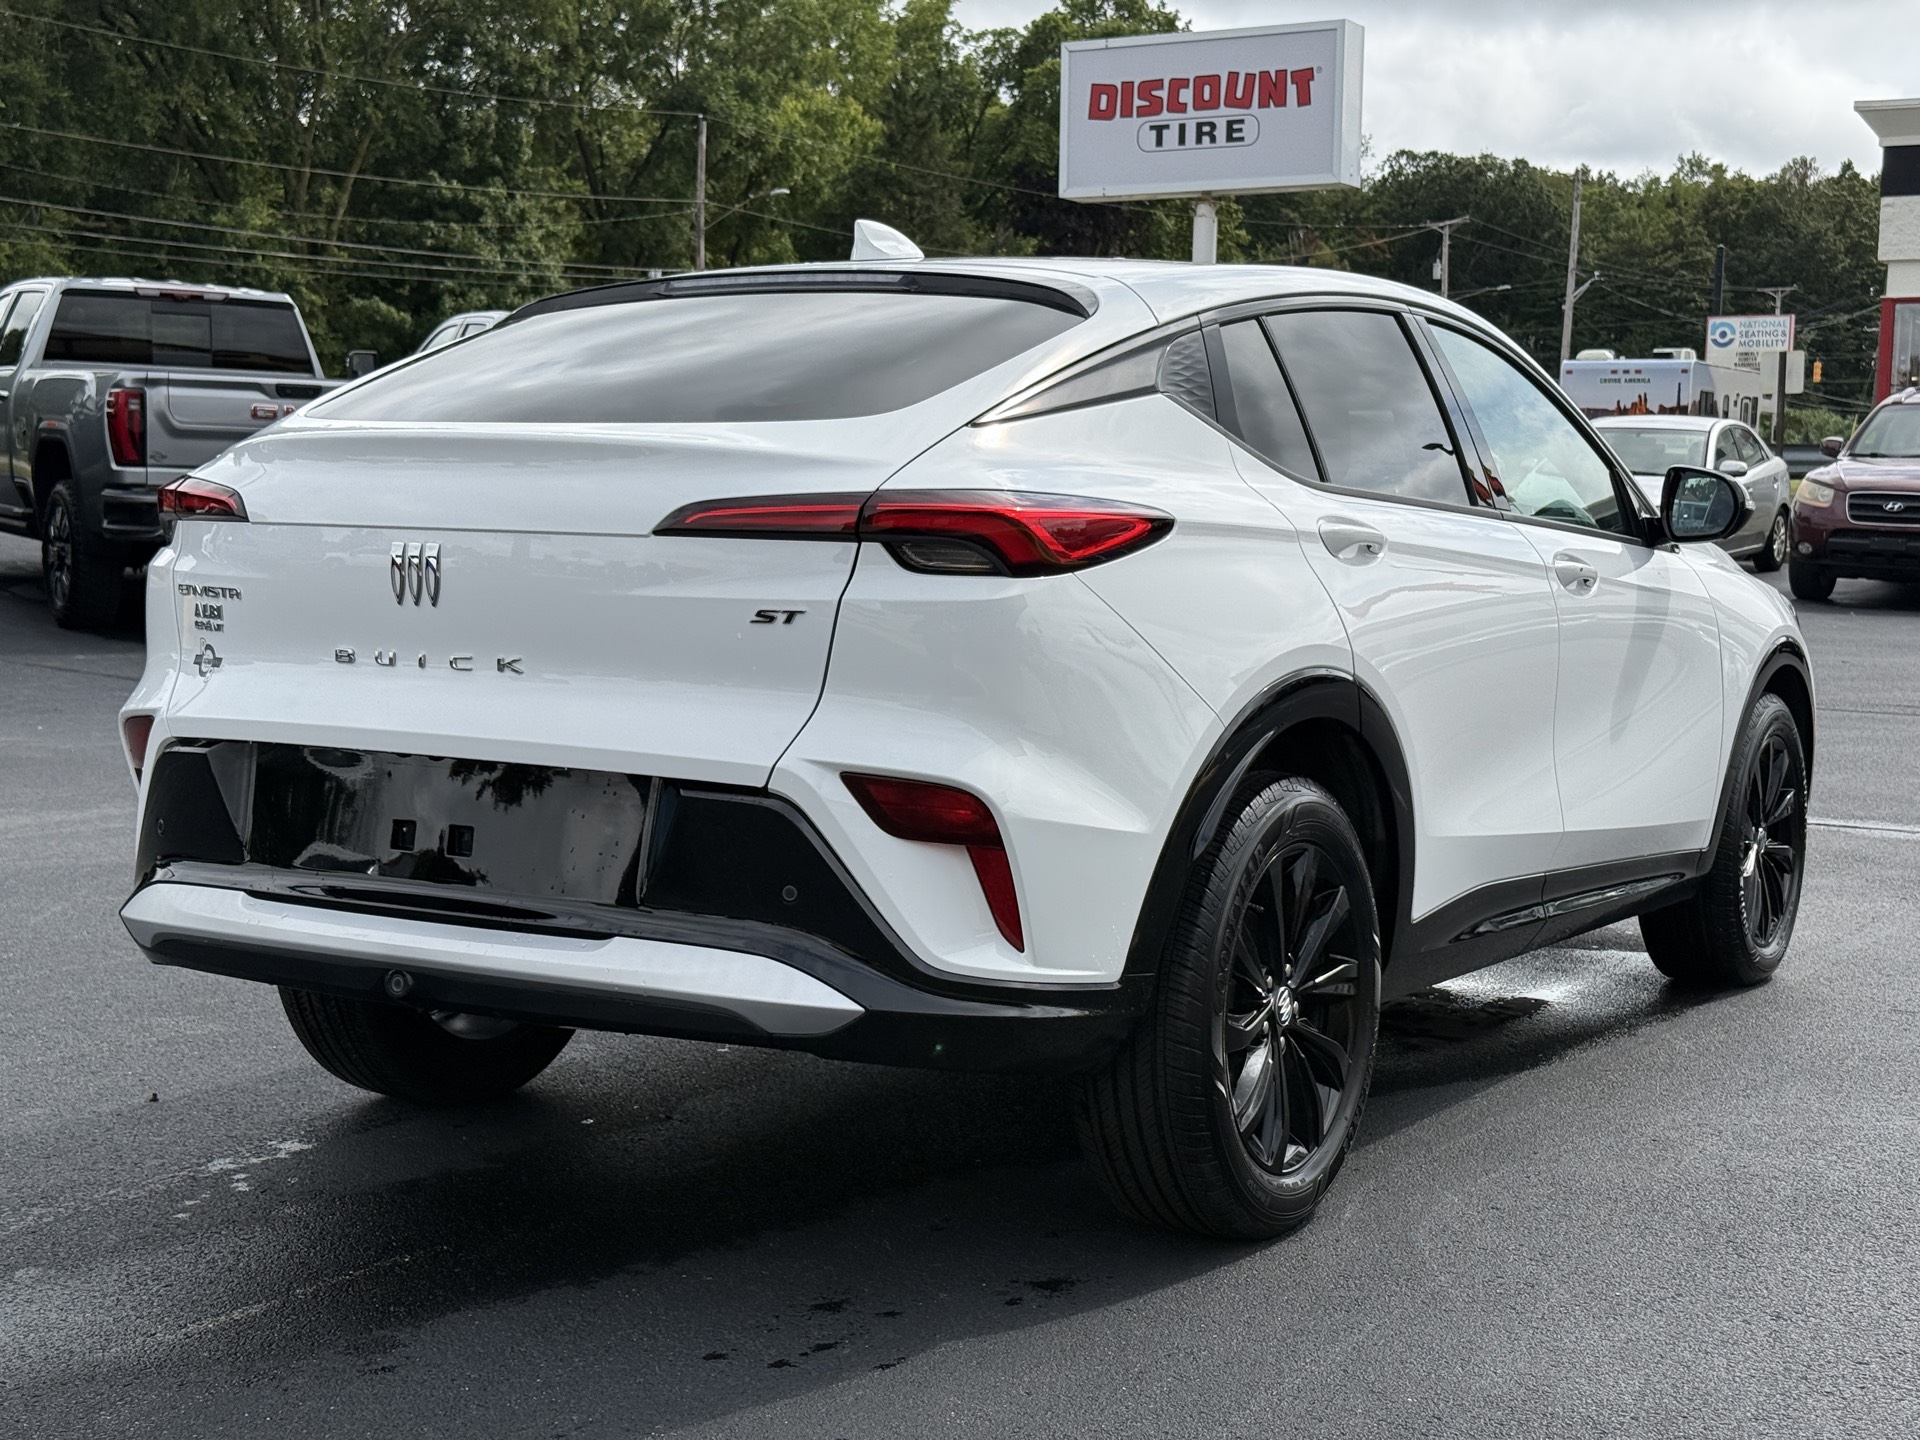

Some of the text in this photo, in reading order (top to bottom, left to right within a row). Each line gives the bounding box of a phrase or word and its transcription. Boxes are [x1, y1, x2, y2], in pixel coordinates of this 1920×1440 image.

[1088, 67, 1314, 121] DISCOUNT
[1149, 119, 1245, 148] TIRE
[1740, 321, 1787, 329] NATIONAL
[1739, 330, 1787, 339] SEATING &
[1739, 339, 1786, 348] MOBILITY
[749, 609, 807, 624] ST
[335, 648, 524, 675] BUICK
